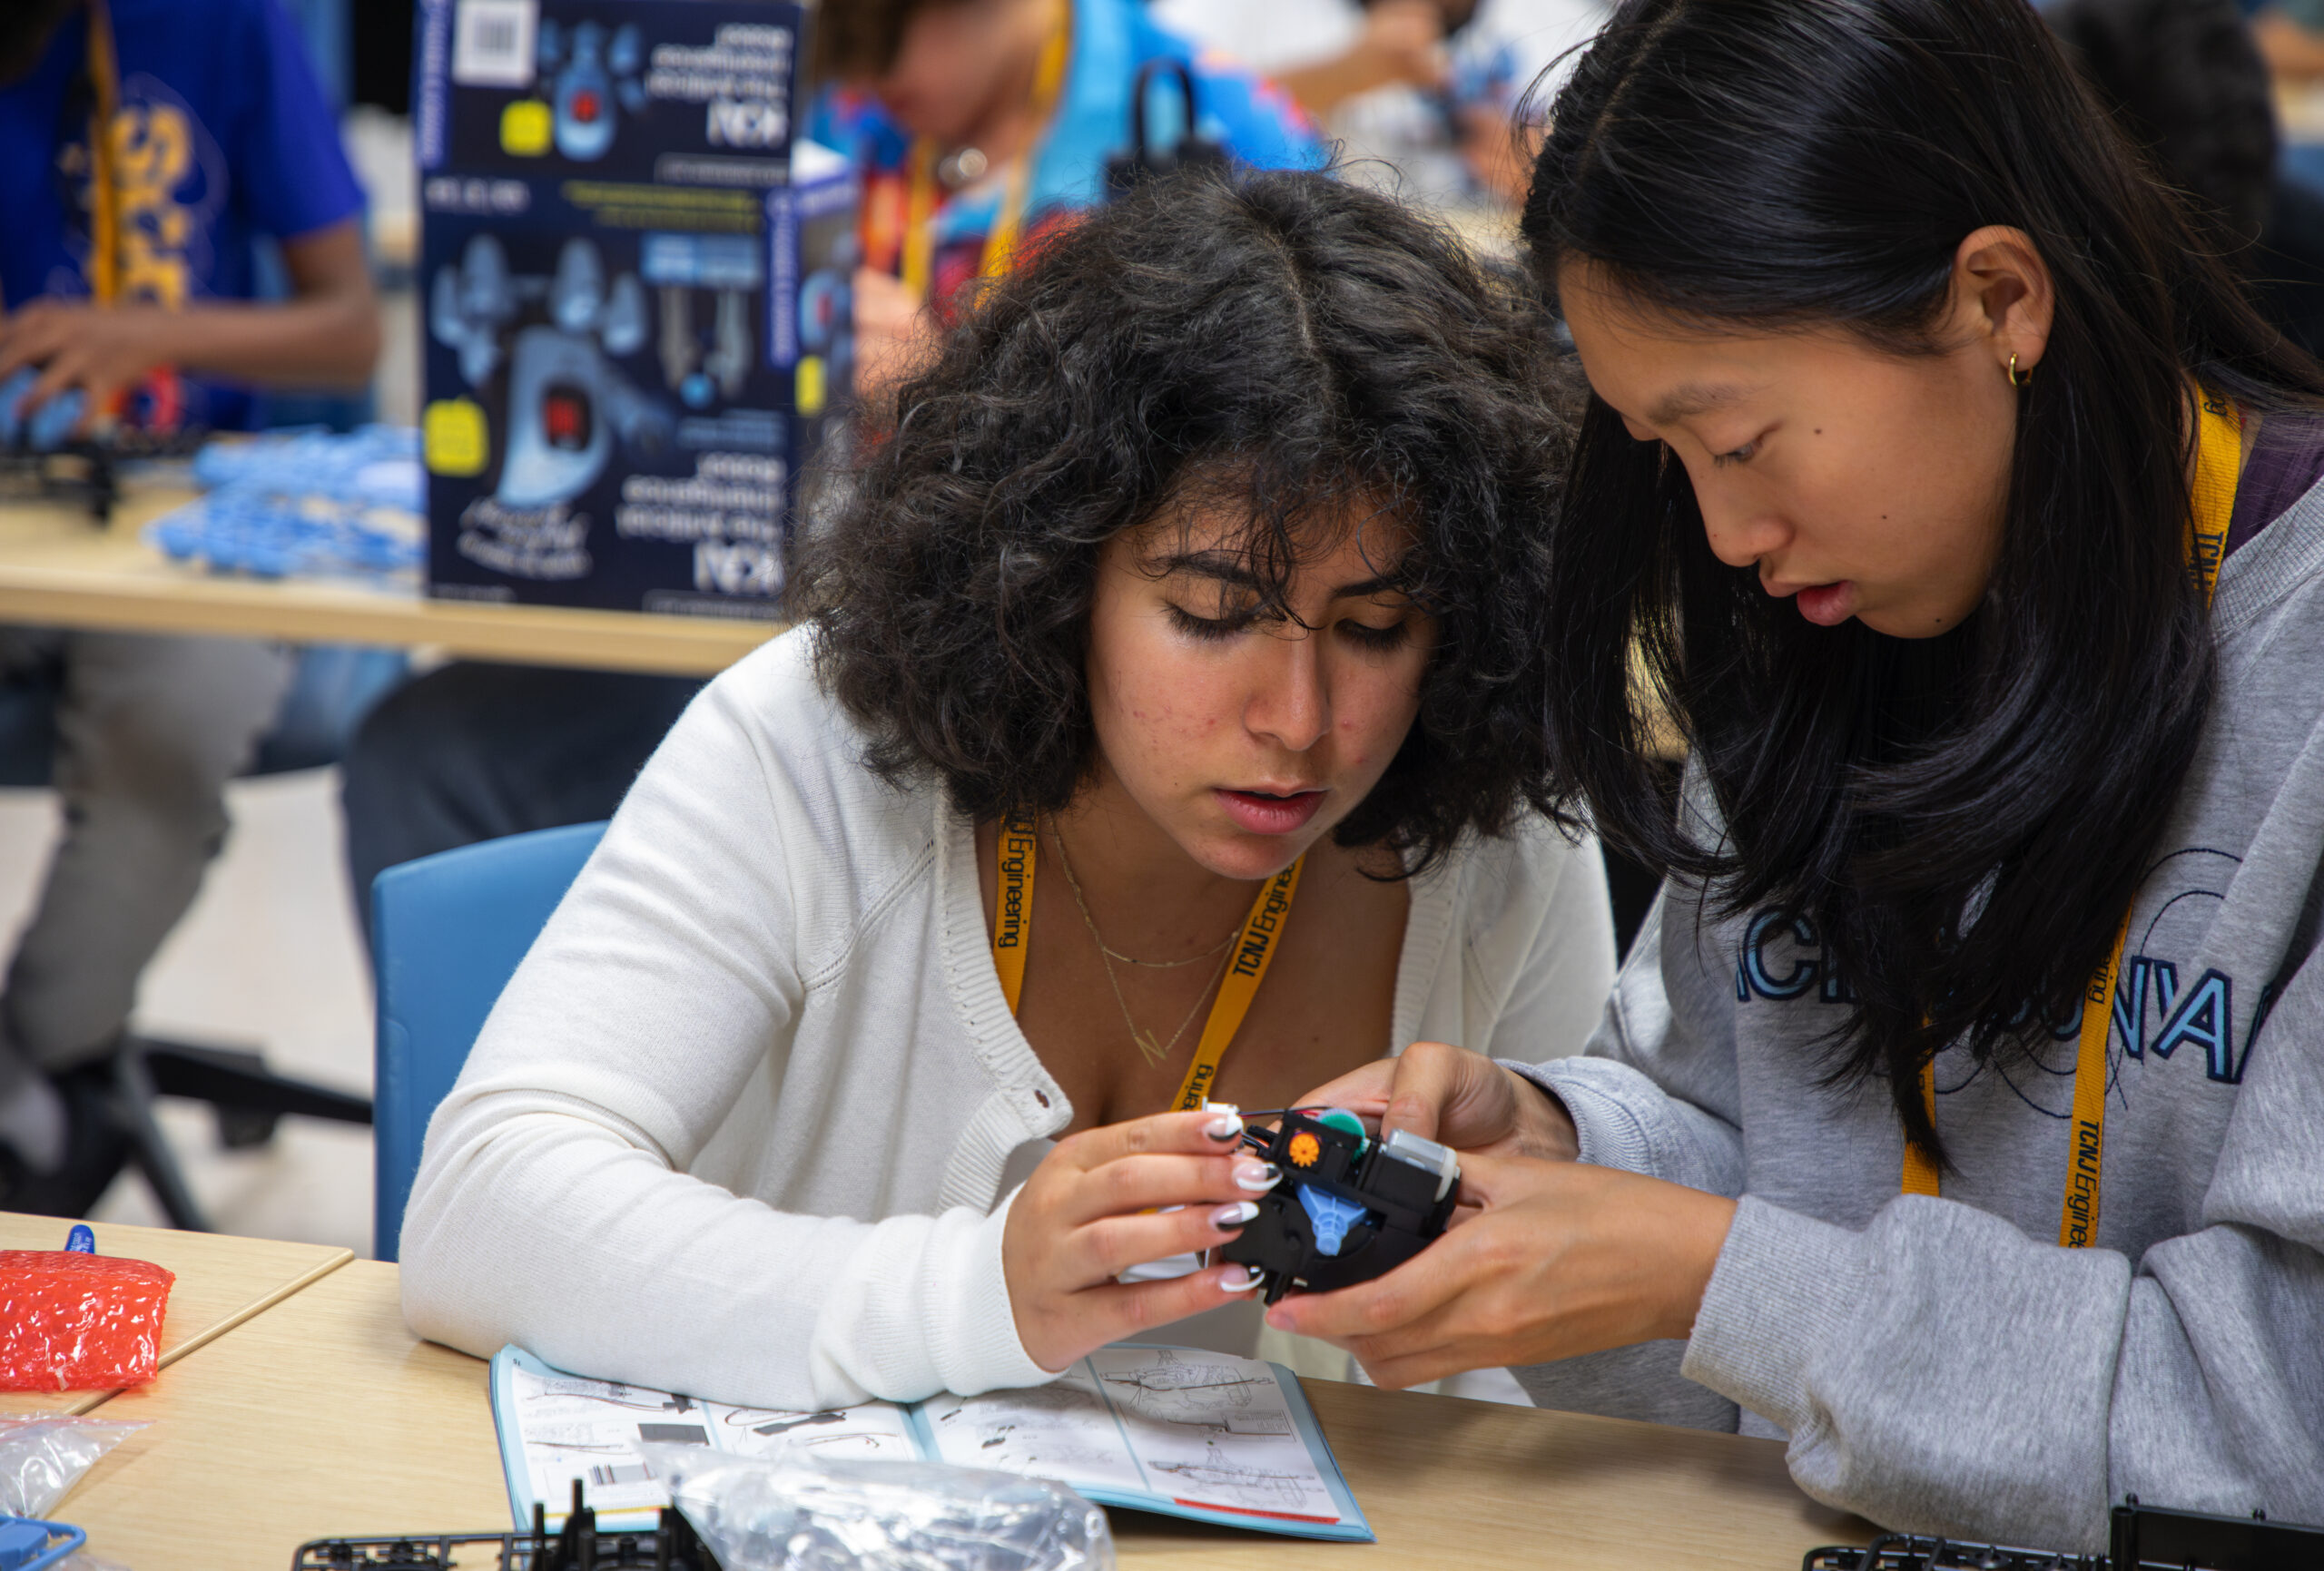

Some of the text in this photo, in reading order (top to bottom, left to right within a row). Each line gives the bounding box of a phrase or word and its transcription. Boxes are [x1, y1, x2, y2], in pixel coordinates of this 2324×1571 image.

[999, 837, 1034, 948] Engineering
[1232, 930, 1270, 977] TCNJ
[2077, 1120, 2100, 1174] TCNJ
